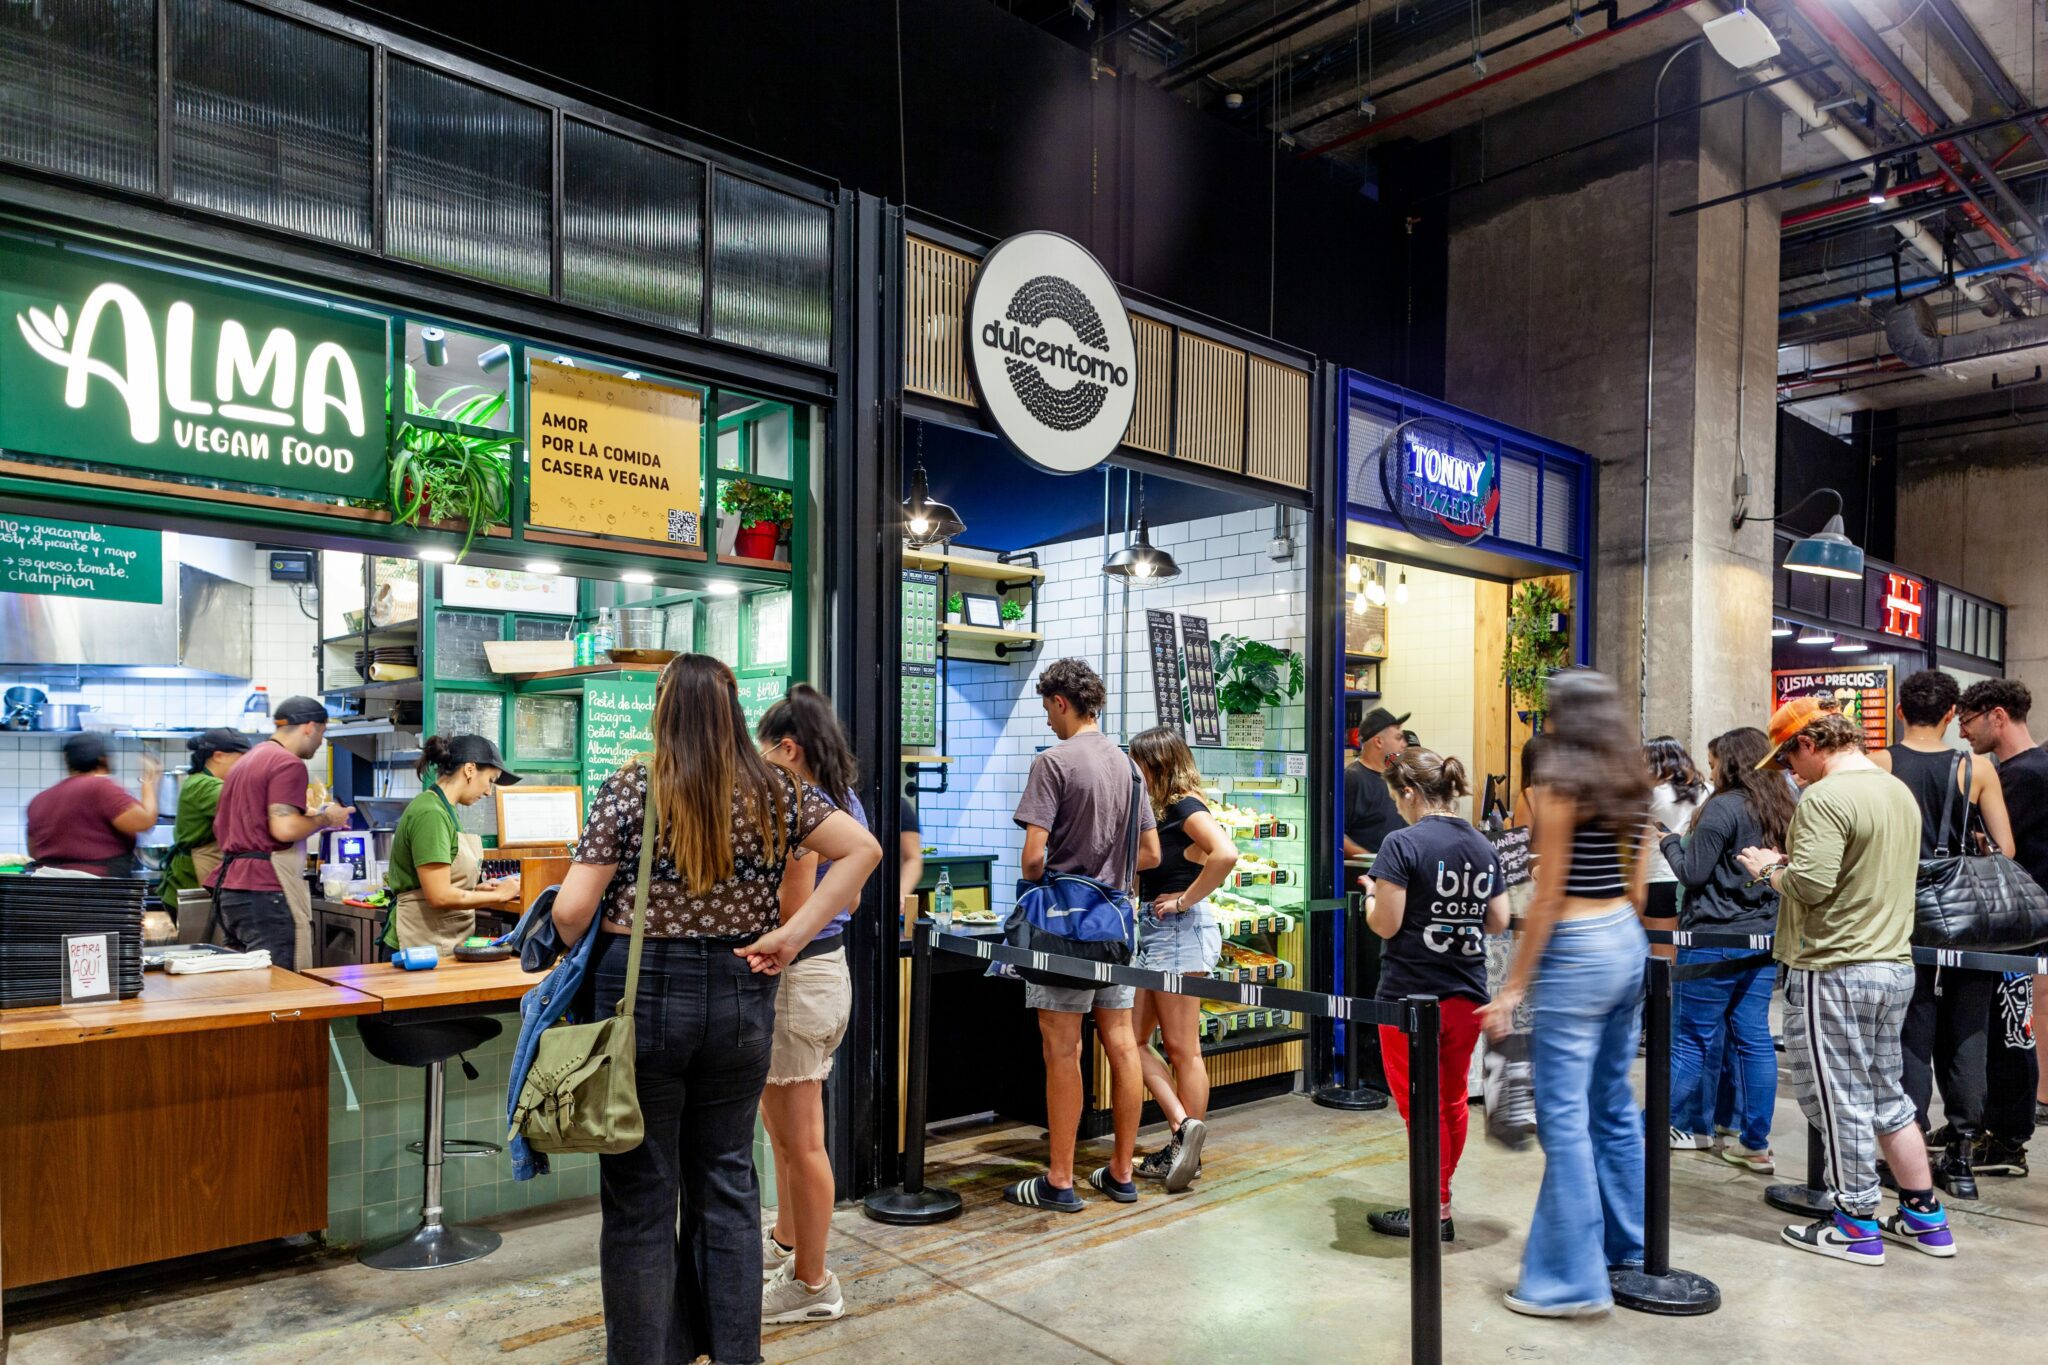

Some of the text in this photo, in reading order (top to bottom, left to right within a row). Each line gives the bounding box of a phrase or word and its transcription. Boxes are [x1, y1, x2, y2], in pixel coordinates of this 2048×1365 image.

[17, 282, 365, 443] ALMA
[982, 319, 1128, 387] dulcentorno
[541, 411, 588, 434] AMOR
[173, 419, 354, 474] VEGAN FOOD
[541, 434, 661, 469] POR LA COMIDA
[541, 457, 670, 492] CASERA VEGANA
[1411, 441, 1486, 497] TONNY
[0, 531, 25, 549] asty
[92, 547, 99, 558] y
[104, 547, 137, 564] mayo
[8, 568, 95, 591] champiñon
[1783, 676, 1815, 694] LISTA
[1825, 672, 1876, 688] PRECIOS
[589, 690, 616, 709] Pastel
[589, 708, 633, 728] Lasagna
[1430, 901, 1487, 916] cosas
[929, 930, 940, 948] UT
[1672, 930, 1692, 946] MUT
[1749, 934, 1771, 950] MUT
[70, 944, 100, 957] RETIRA
[977, 940, 992, 960] MUT
[1032, 951, 1049, 971] MUT
[1937, 949, 1963, 968] MUT
[72, 954, 102, 978] AQUÍ
[1095, 962, 1112, 982] MUT
[1164, 971, 1183, 994] MUT
[1241, 983, 1263, 1007] MUT
[1328, 995, 1352, 1020] MUT
